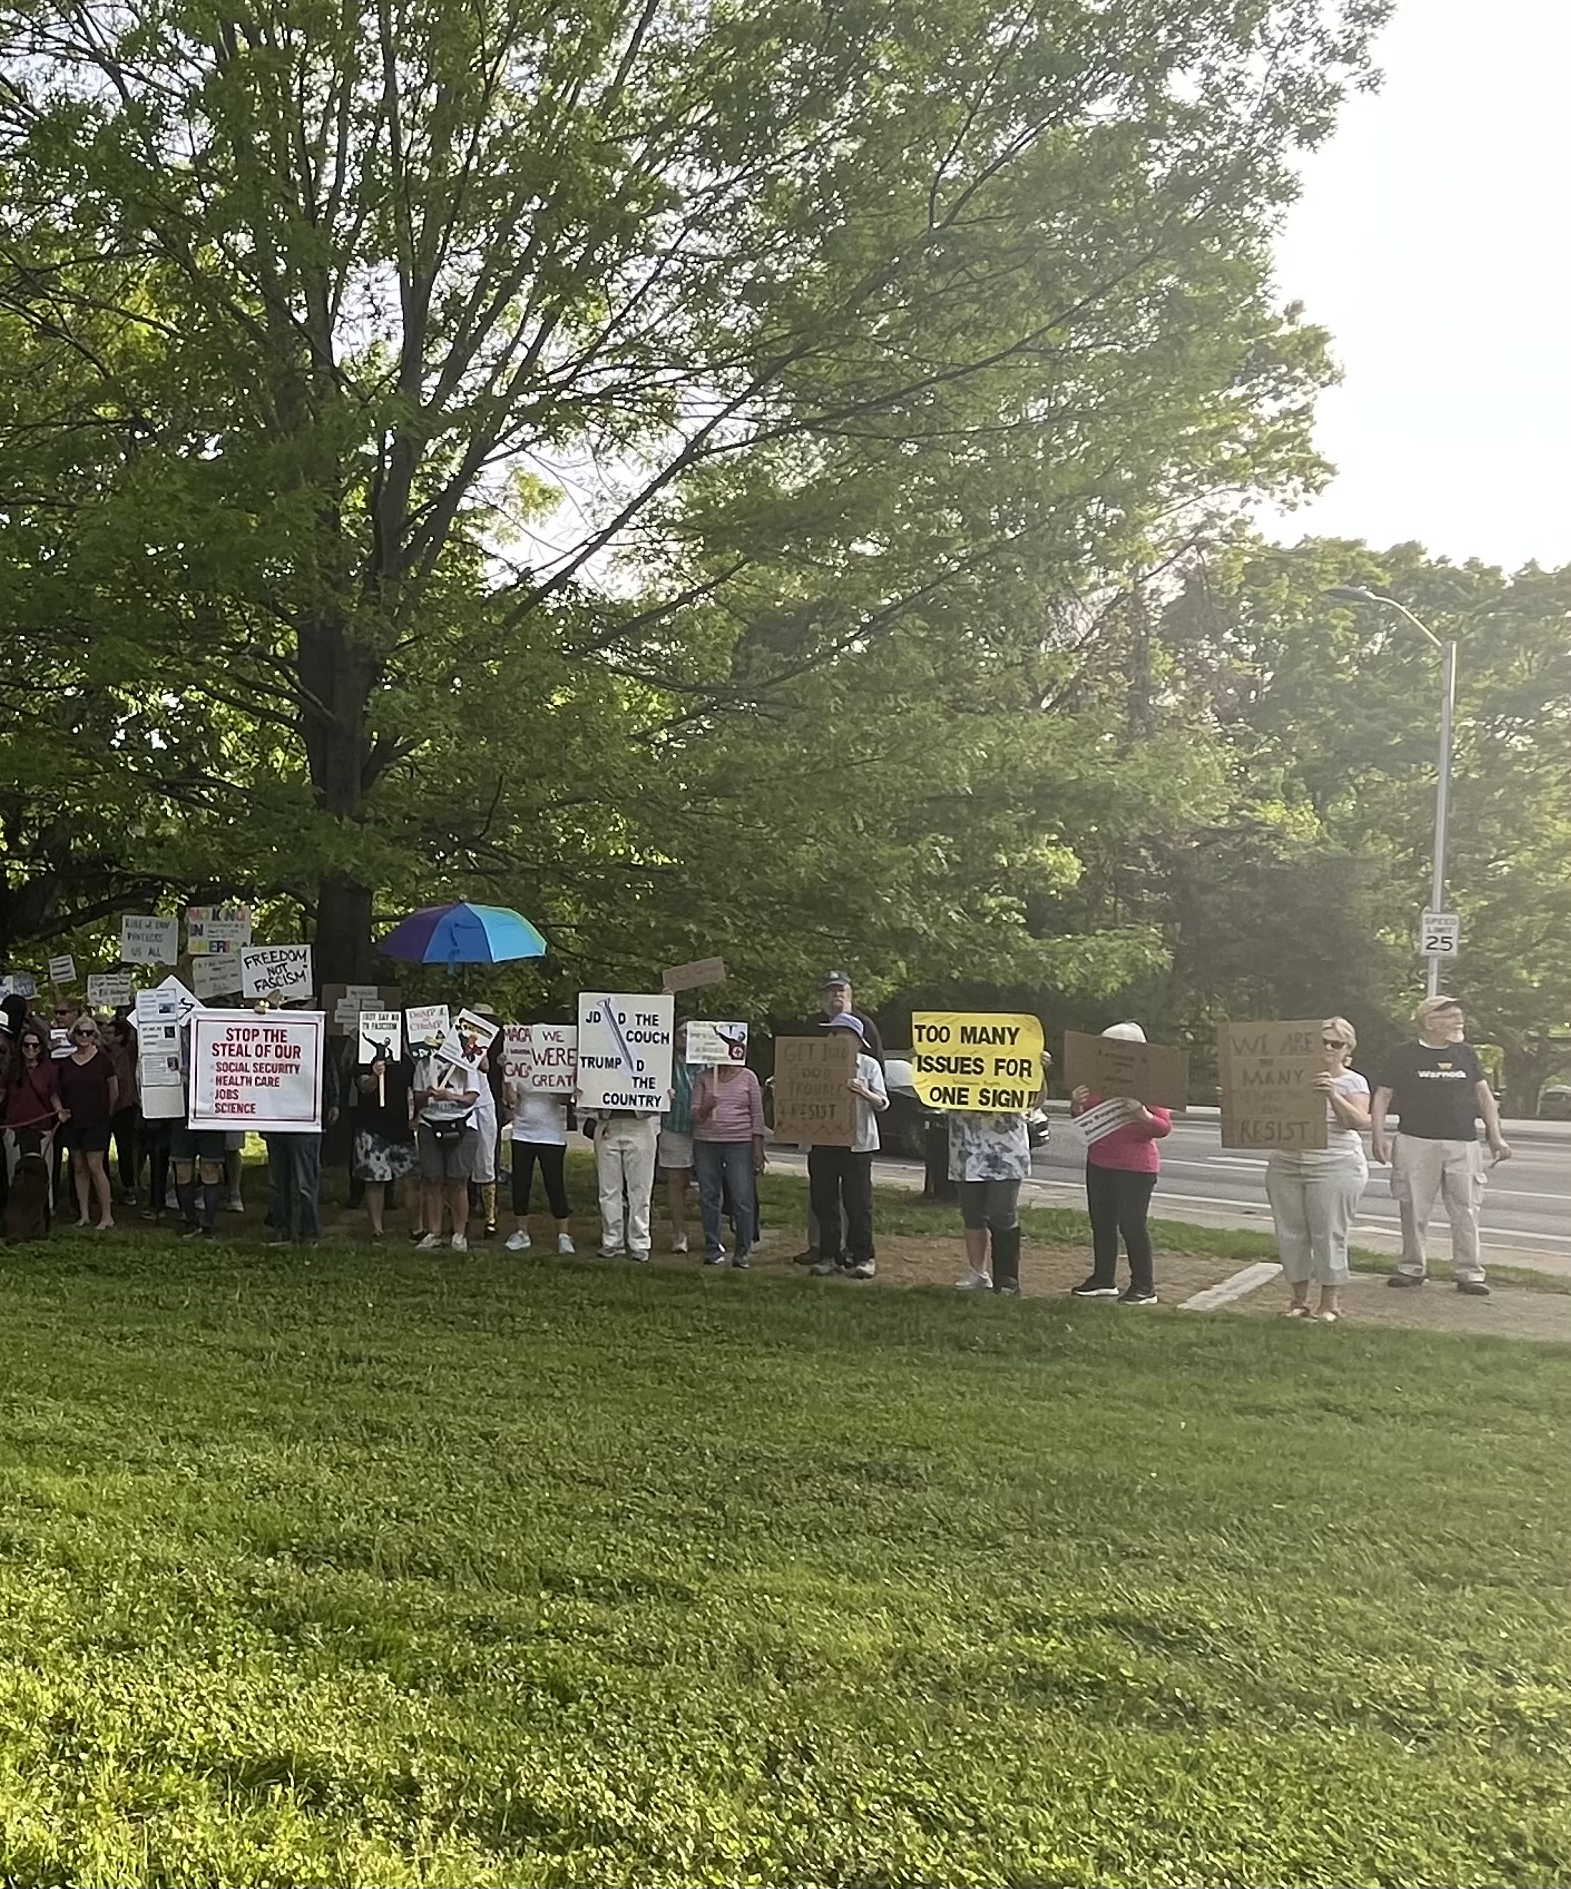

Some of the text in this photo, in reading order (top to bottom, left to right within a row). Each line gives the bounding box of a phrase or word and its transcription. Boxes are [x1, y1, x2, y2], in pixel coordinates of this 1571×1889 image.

[1424, 917, 1457, 925] SPEED
[1425, 935, 1453, 951] 25
[243, 949, 307, 970] FREEDOM
[266, 962, 288, 976] NOT
[253, 970, 307, 993] FASCISM
[585, 1011, 601, 1024] JD
[635, 1013, 660, 1027] THE
[225, 1027, 288, 1043] STOP THE
[542, 1030, 565, 1043] WE
[626, 1030, 670, 1045] COUCH
[914, 1024, 1021, 1046] TOO MANY
[211, 1042, 301, 1060] STEAL OF OUR
[1229, 1031, 1315, 1056] WE ARE
[531, 1048, 578, 1067] WERE
[784, 1042, 815, 1062] GET
[215, 1061, 301, 1075] SOCIAL SECURITY
[579, 1056, 622, 1070] TRUMP
[917, 1055, 1033, 1078] ISSUES FOR
[215, 1075, 280, 1088] HEALTH CARE
[631, 1076, 657, 1090] THE
[1242, 1067, 1304, 1087] MANY
[214, 1089, 239, 1101] JOBS
[602, 1092, 662, 1108] COUNTRY
[930, 1086, 970, 1106] ONE
[214, 1103, 257, 1114] SCIENCE
[1240, 1121, 1311, 1144] RESIST
